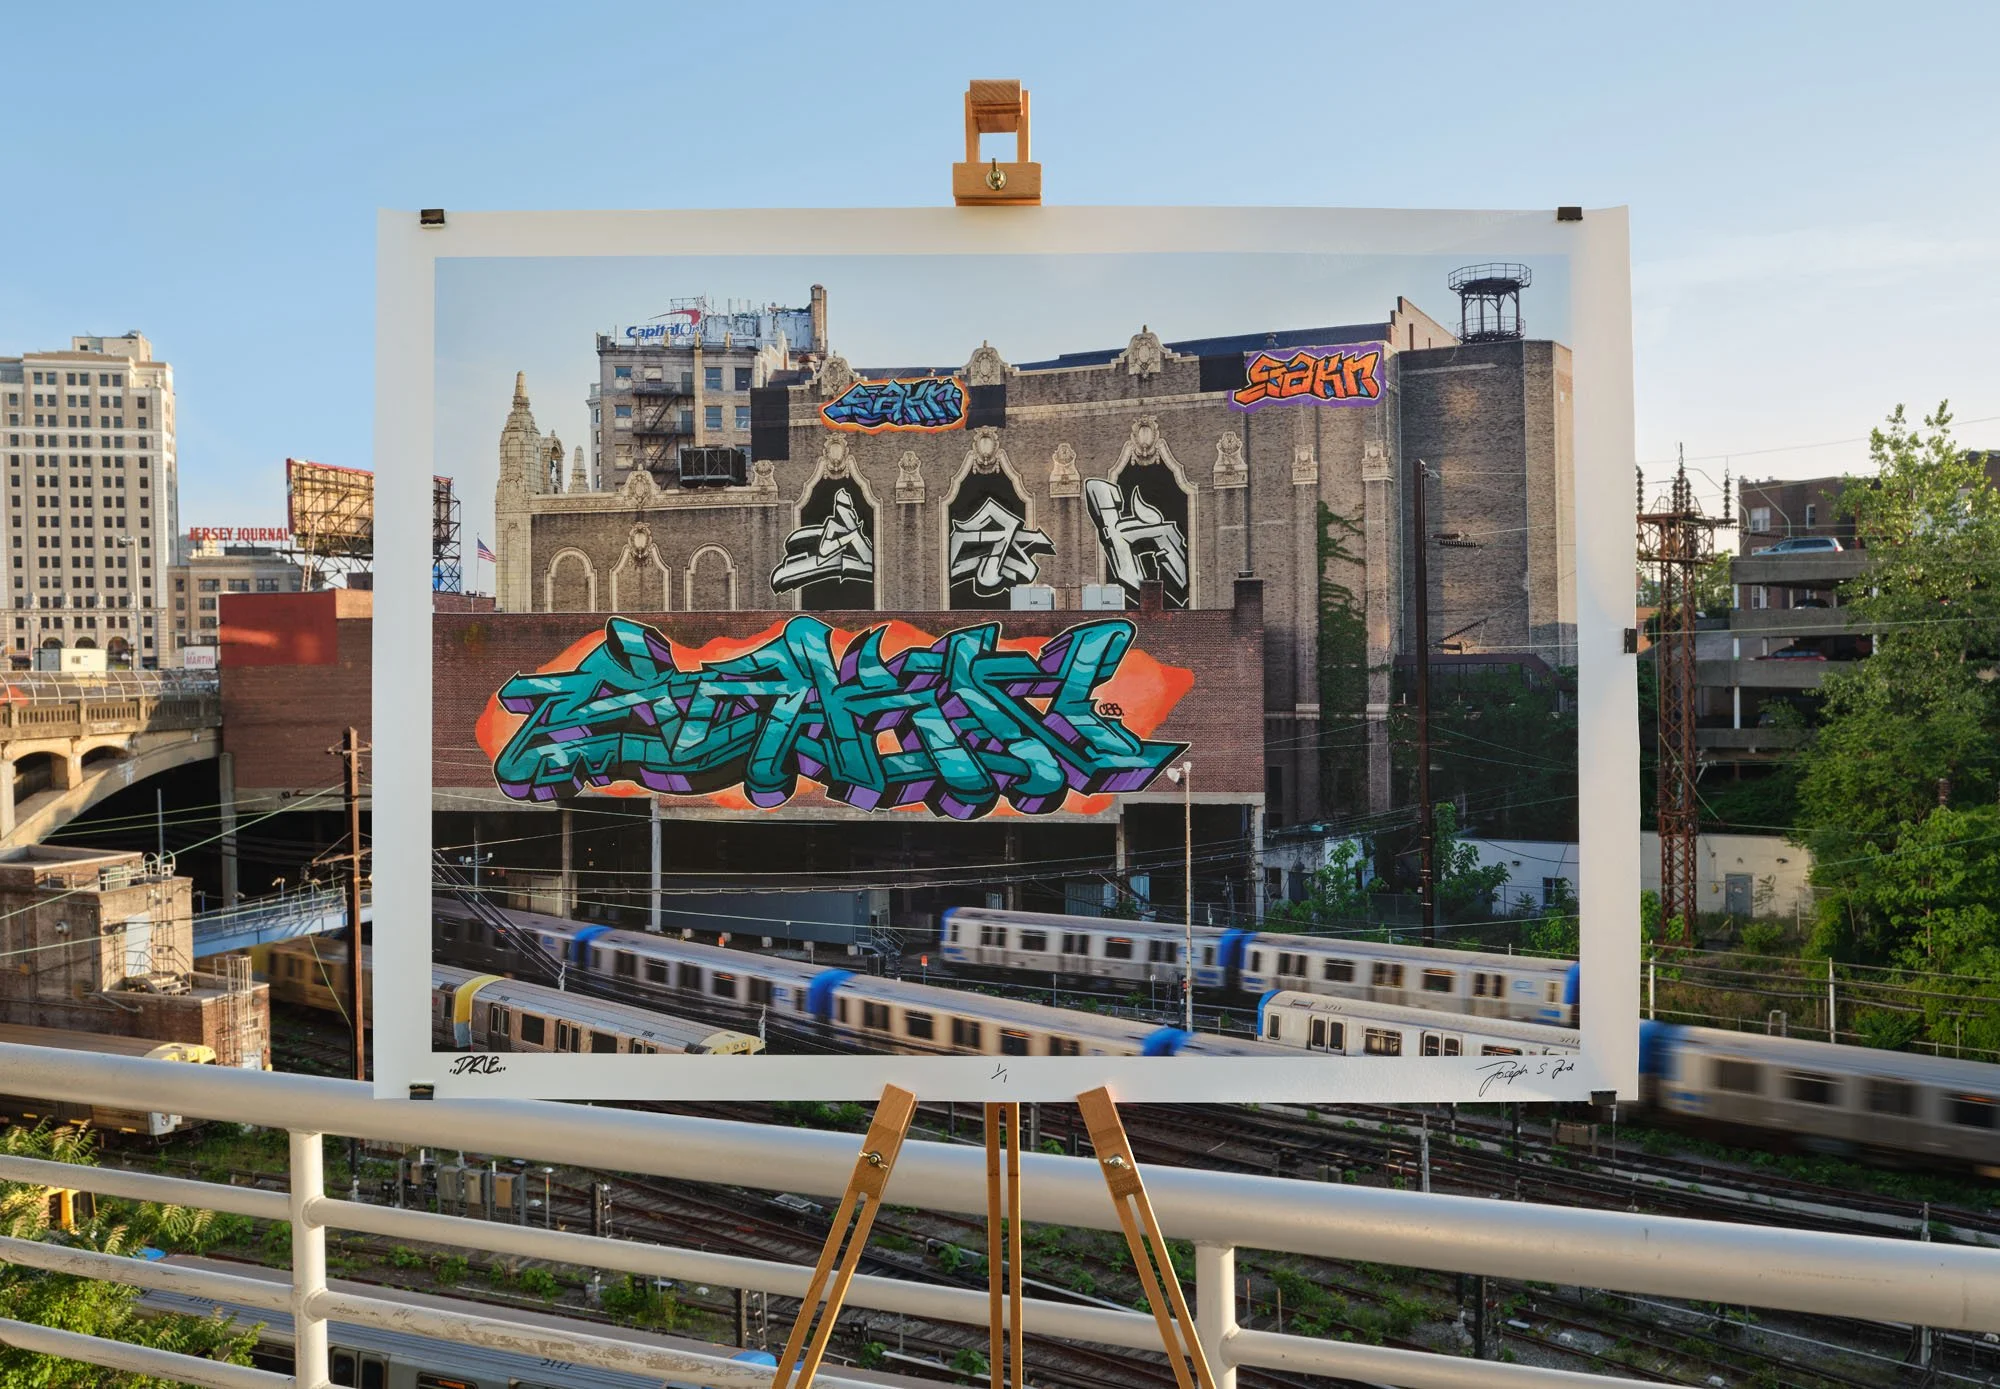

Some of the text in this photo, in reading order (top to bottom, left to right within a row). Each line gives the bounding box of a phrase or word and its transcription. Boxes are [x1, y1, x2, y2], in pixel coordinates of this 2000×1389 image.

[188, 527, 289, 541] JERSEY JOURNAL
[186, 656, 213, 665] MARTIN
[1476, 1060, 1528, 1097] Joseph
